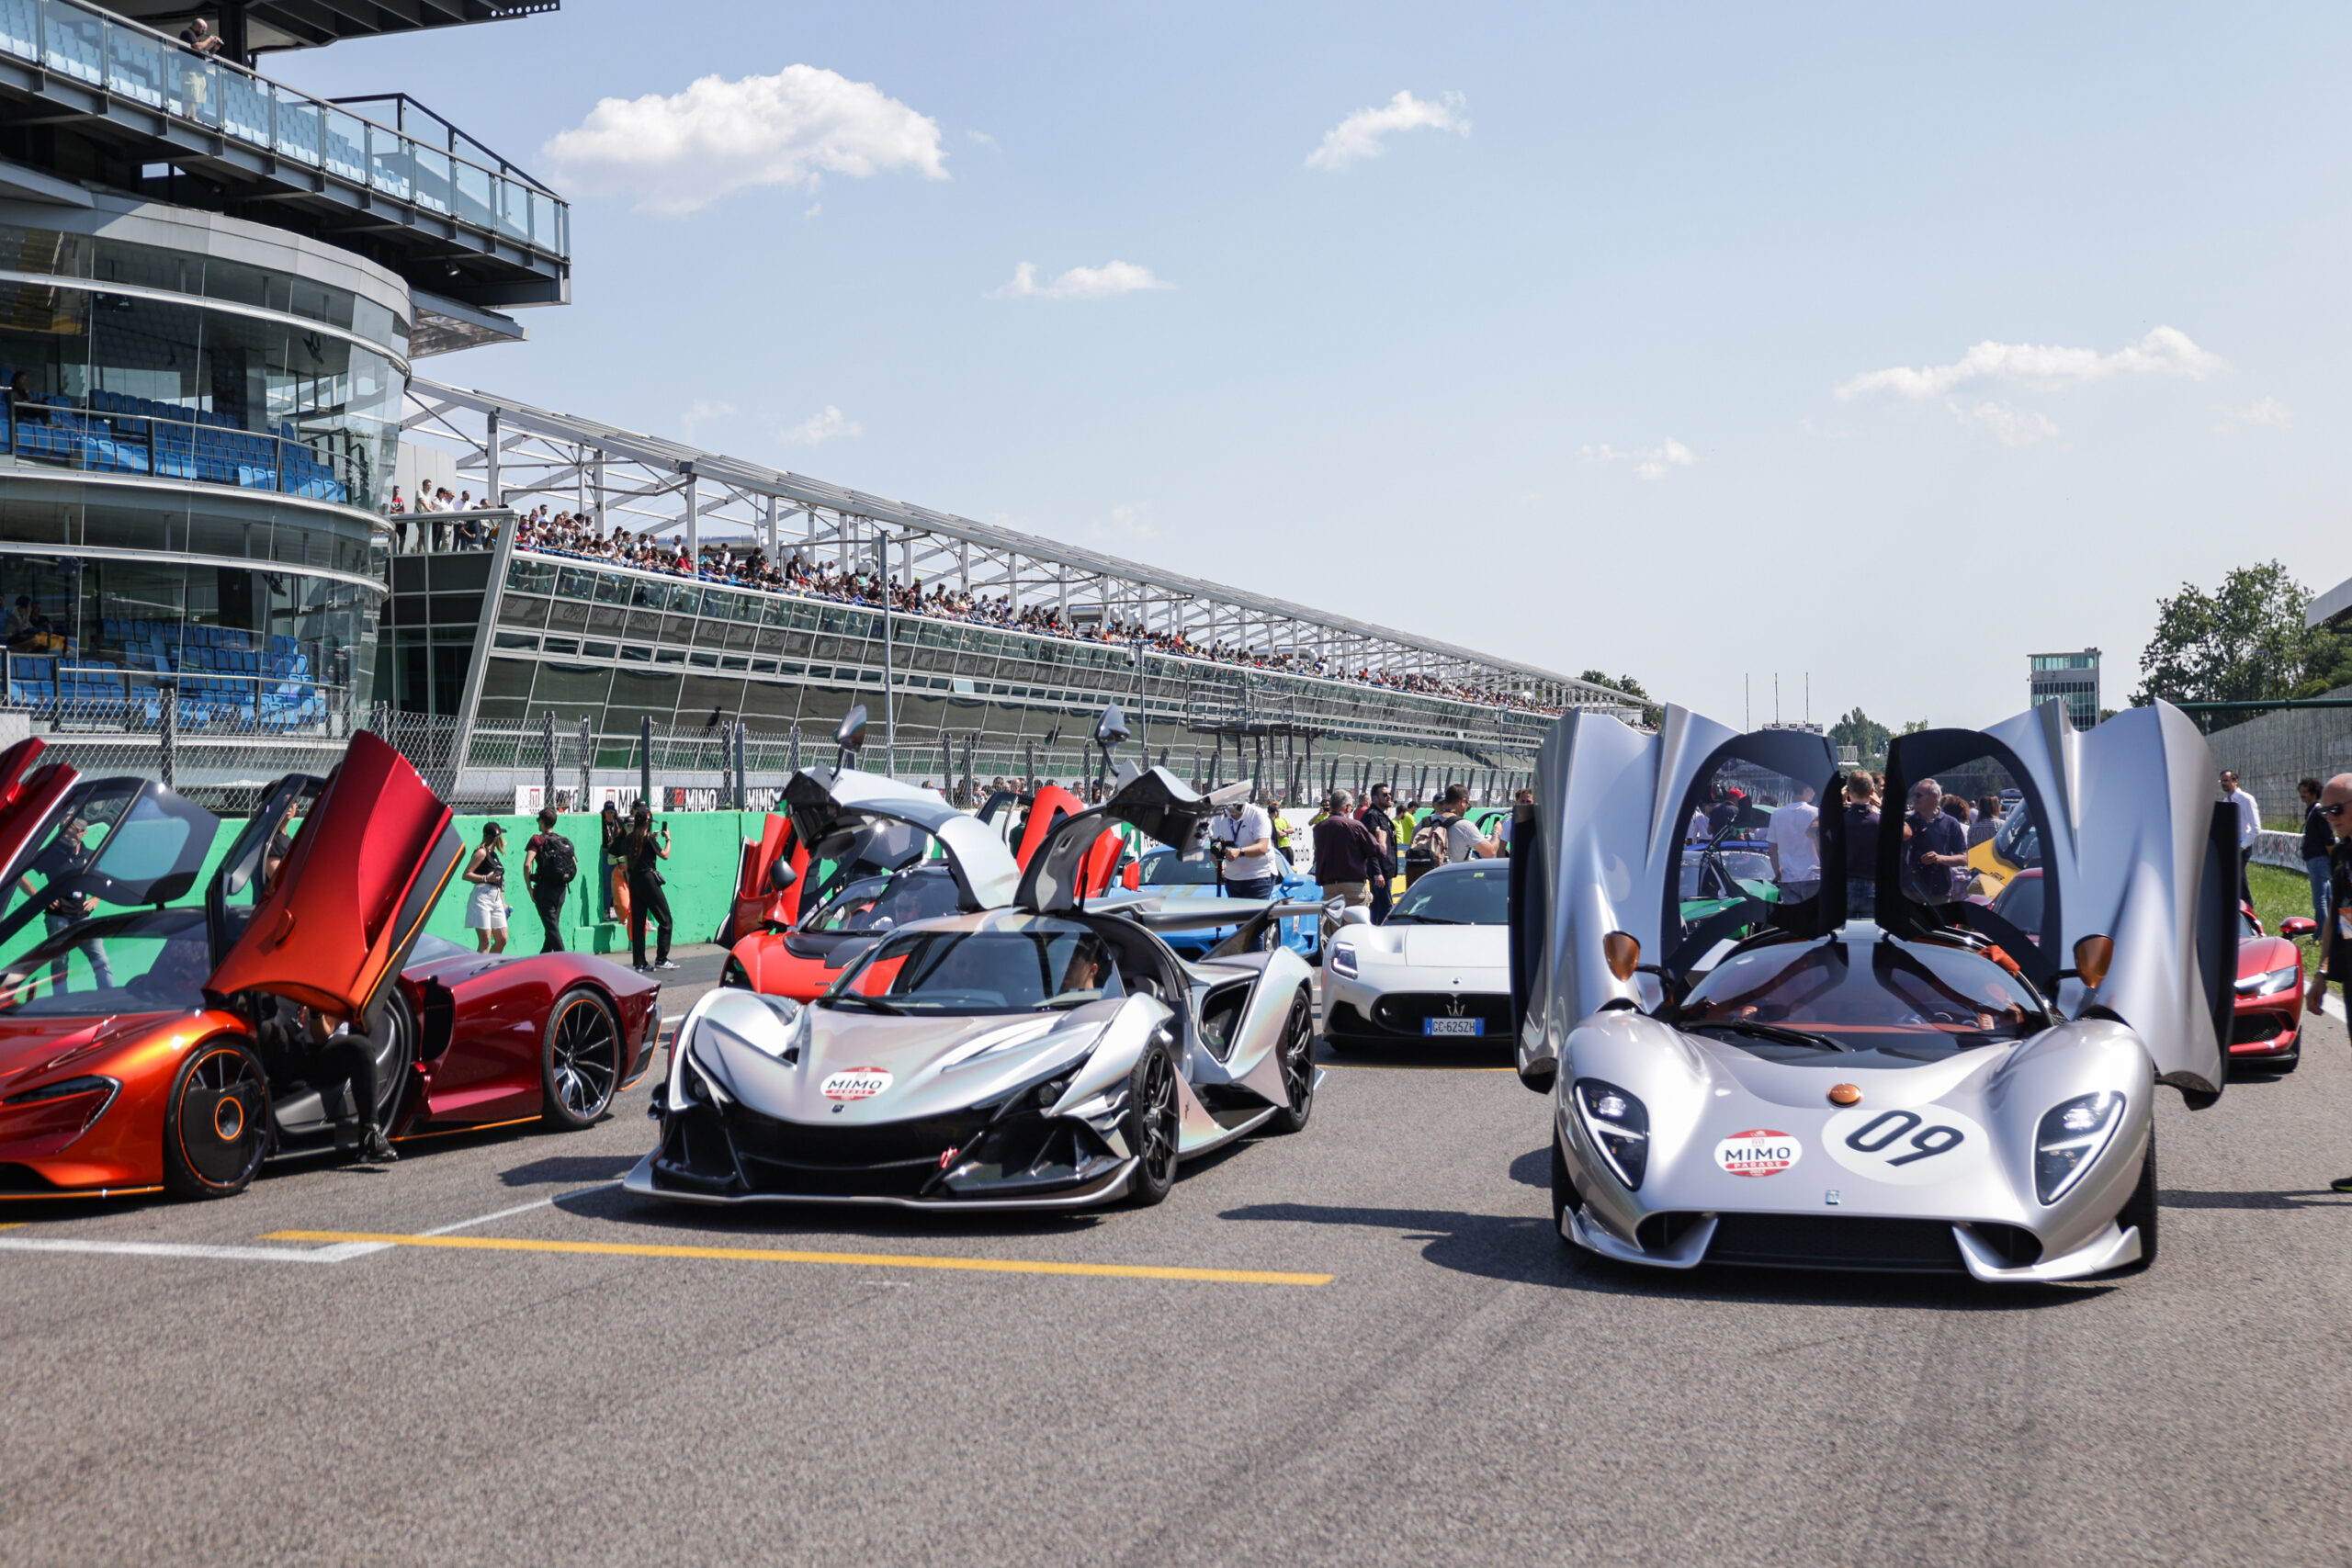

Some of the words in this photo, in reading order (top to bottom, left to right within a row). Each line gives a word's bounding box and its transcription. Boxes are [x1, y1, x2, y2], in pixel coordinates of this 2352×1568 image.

[685, 788, 717, 812] MIMO
[828, 1079, 883, 1089] MIMO
[1845, 1110, 1964, 1167] 09
[1724, 1146, 1791, 1162] MIMO
